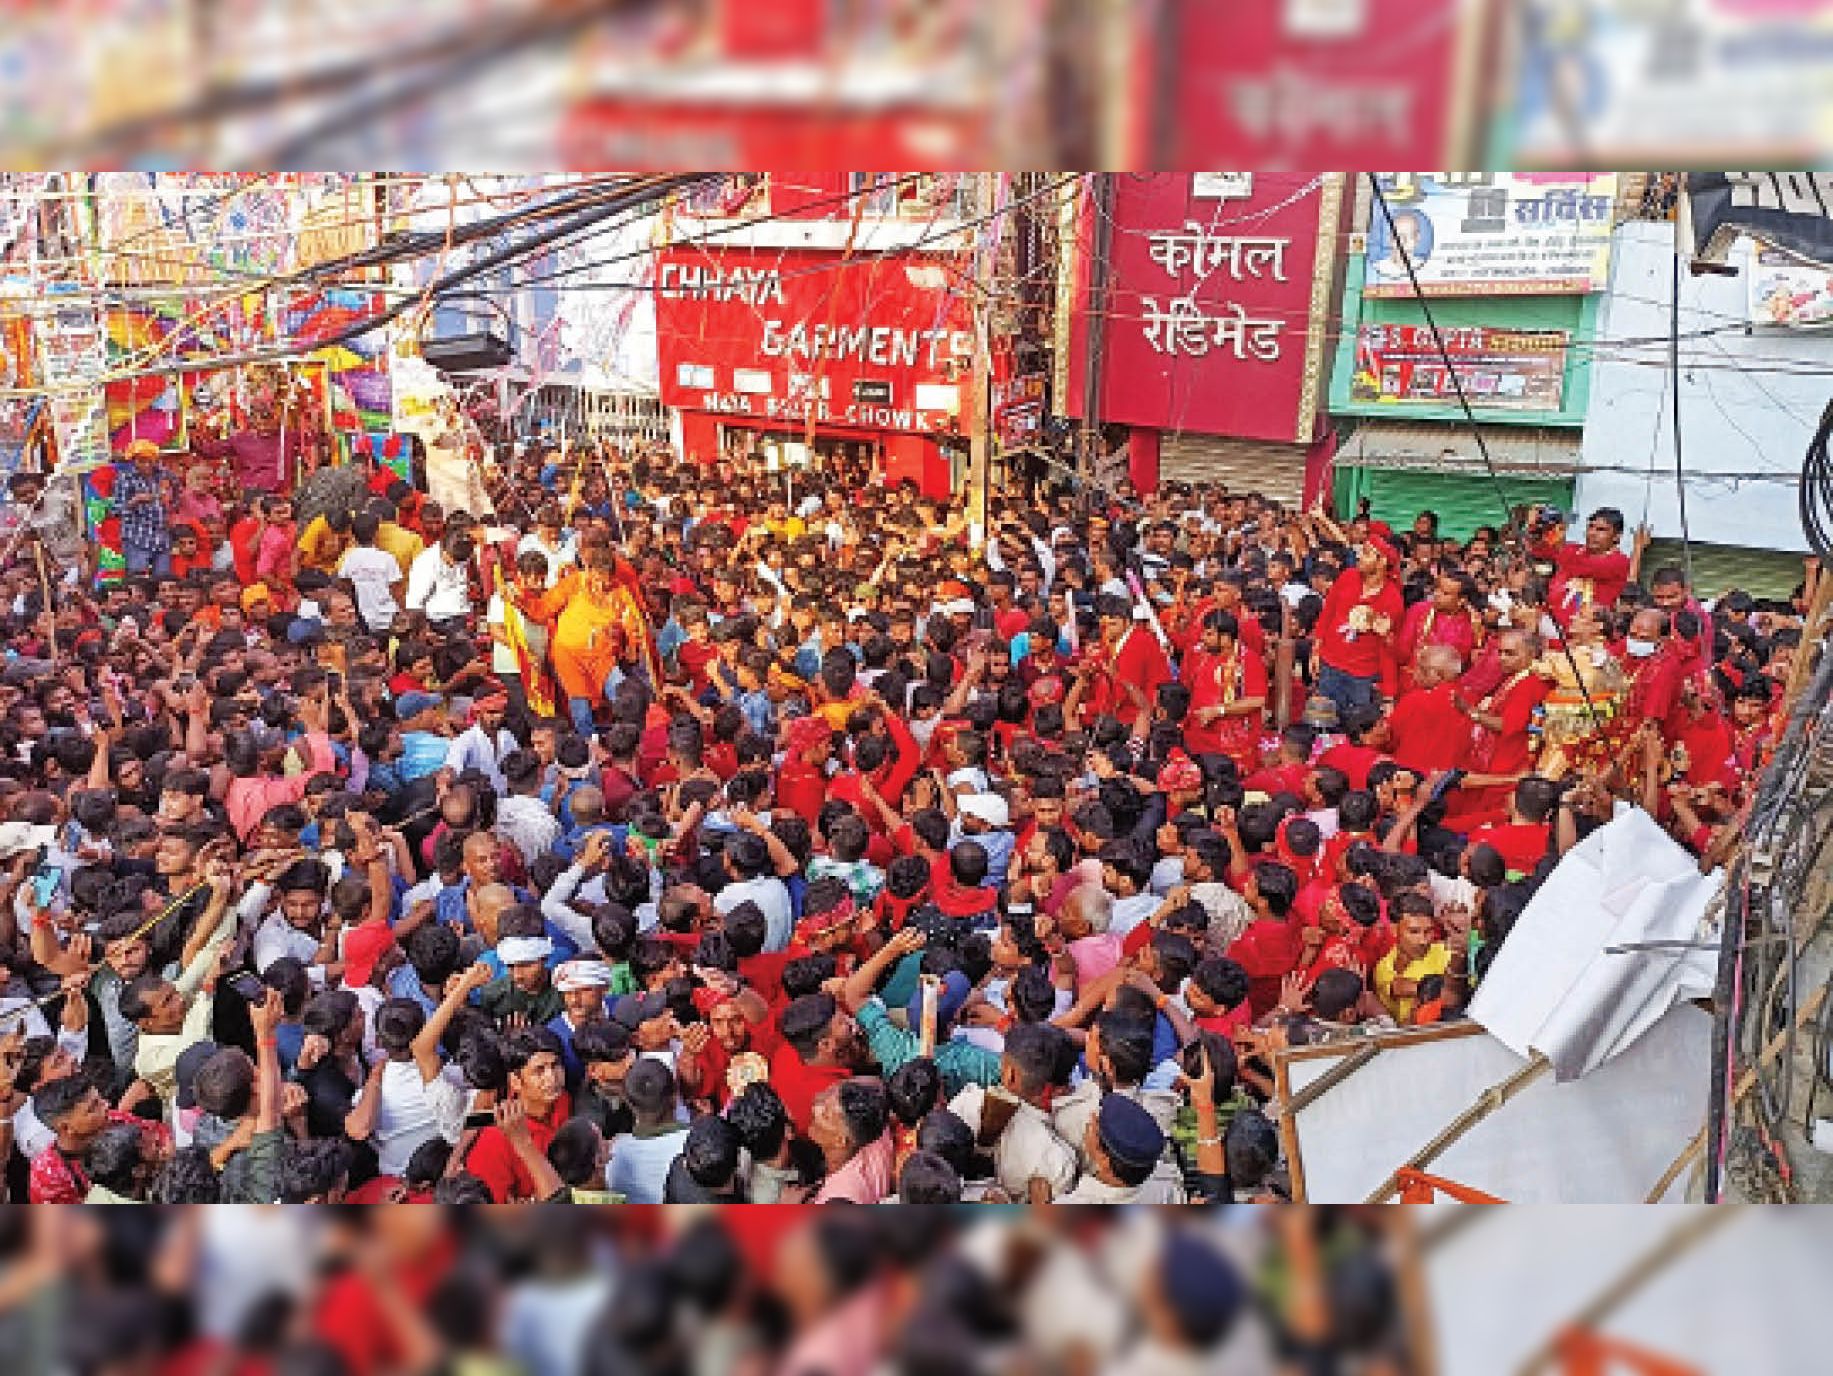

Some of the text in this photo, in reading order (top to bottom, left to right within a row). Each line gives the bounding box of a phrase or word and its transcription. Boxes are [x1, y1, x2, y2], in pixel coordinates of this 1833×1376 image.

[1149, 219, 1291, 281] कोमल
[660, 263, 784, 304] CHHAYA
[1140, 296, 1286, 360] रेडिमेड
[846, 405, 931, 430] CHOWK
